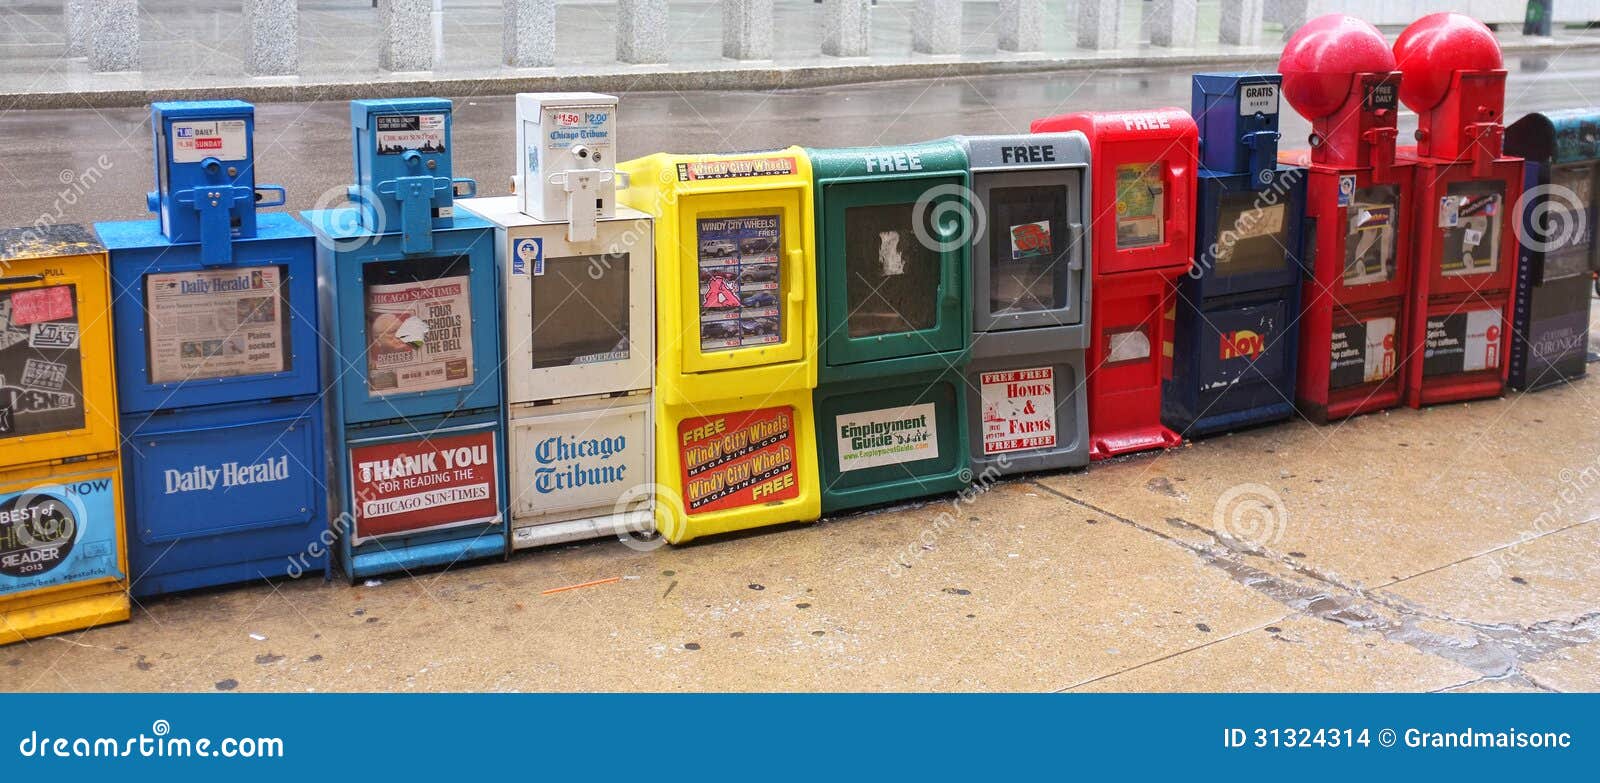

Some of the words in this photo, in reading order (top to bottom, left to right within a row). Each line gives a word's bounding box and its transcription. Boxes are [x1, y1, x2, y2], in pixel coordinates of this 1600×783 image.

[1246, 87, 1273, 98] GRATIS
[1376, 86, 1391, 94] FREE
[1375, 95, 1393, 103] DAILY
[1122, 114, 1171, 131] FREE
[195, 129, 214, 137] DAILY
[550, 131, 579, 141] Chicago
[580, 129, 609, 139] Tribune
[195, 139, 222, 149] SUNDAY
[1001, 144, 1056, 163] FREE
[754, 158, 792, 172] Wheels
[864, 152, 923, 173] FREE
[678, 164, 688, 181] FREE
[697, 170, 791, 180] MAGAZINE.COM
[702, 222, 726, 231] WINDY
[728, 220, 742, 229] CITY
[45, 268, 65, 277] PULL
[181, 279, 209, 294] Daily
[213, 276, 250, 291] Herald
[372, 293, 409, 304] HICAGO
[430, 304, 452, 318] FOUR
[423, 315, 461, 329] SCHOOLS
[424, 329, 450, 342] SAVED
[452, 327, 461, 339] AT
[425, 342, 442, 354] THE
[443, 339, 462, 352] BELL
[985, 374, 1015, 383] FREE
[1020, 369, 1049, 379] FREE
[1008, 383, 1051, 398] HOMES
[1023, 400, 1035, 415] &
[683, 419, 726, 446] FREE
[749, 414, 789, 442] Wheels
[841, 414, 926, 439] Employment
[1009, 418, 1051, 434] FARMS
[535, 435, 626, 464] Chicago
[852, 434, 892, 450] Guide
[988, 440, 1018, 451] FREE
[1023, 436, 1052, 446] FREE
[690, 433, 787, 476] MAGAZINE.COM
[752, 446, 791, 473] Wheels
[359, 452, 437, 483] THANK
[441, 445, 488, 469] YOU
[164, 466, 221, 494] Daily
[222, 455, 289, 487] Herald
[379, 481, 400, 494] FOR
[404, 472, 450, 489] READING
[454, 469, 473, 481] THE
[535, 463, 626, 494] Tribune
[65, 480, 109, 497] NOW
[692, 464, 789, 508] MAGAZINE.COM
[752, 473, 794, 500] FREE
[367, 497, 421, 516] CHICAGO
[425, 486, 486, 506] SUN-TIMES
[0, 506, 39, 524] BEST
[42, 504, 54, 516] of
[0, 517, 74, 550] HICAGO
[2, 547, 60, 568] READER
[20, 564, 43, 573] 2013
